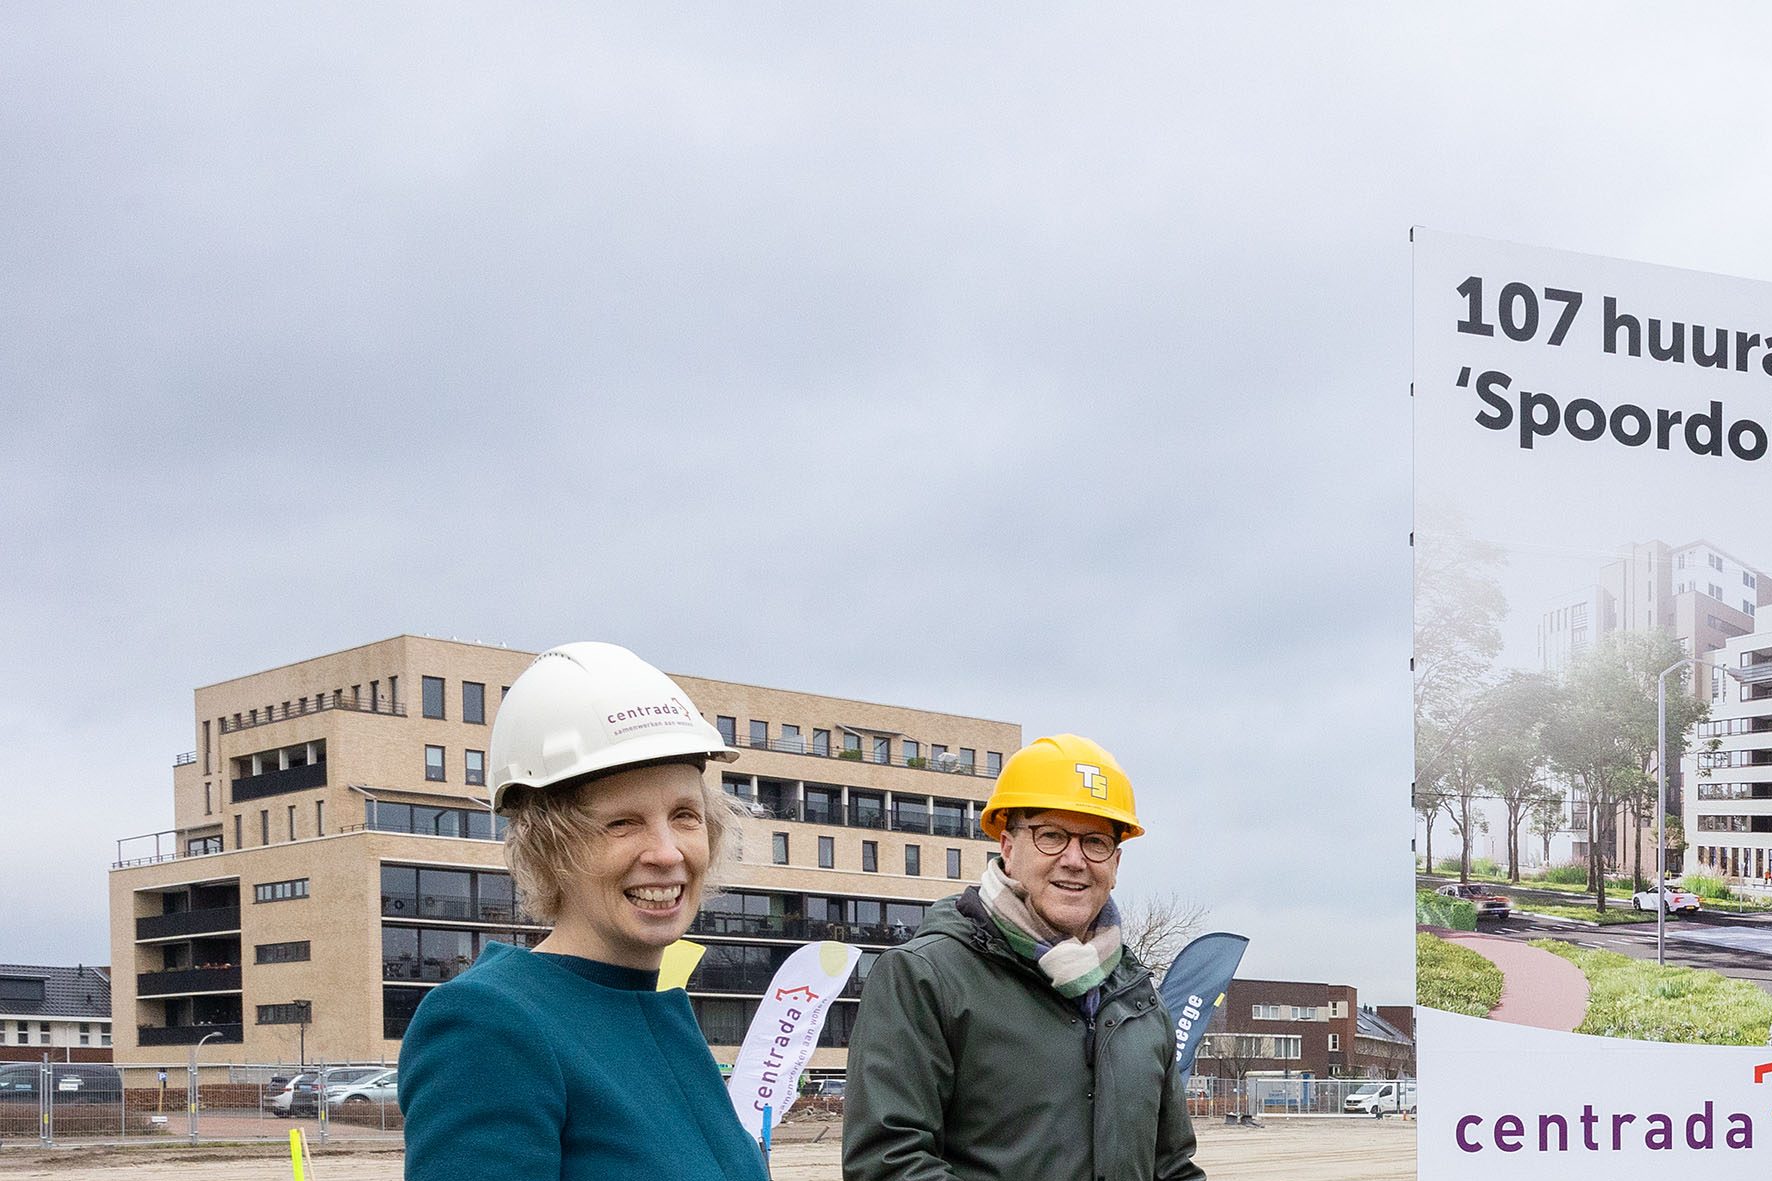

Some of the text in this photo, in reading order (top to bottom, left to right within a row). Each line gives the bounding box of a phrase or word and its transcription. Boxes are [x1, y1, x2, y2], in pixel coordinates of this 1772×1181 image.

[1457, 277, 1583, 347] 107
[607, 703, 679, 724] centrada
[1075, 763, 1108, 801] TS
[754, 1007, 802, 1113] centrada
[1455, 1101, 1753, 1153] centrada
